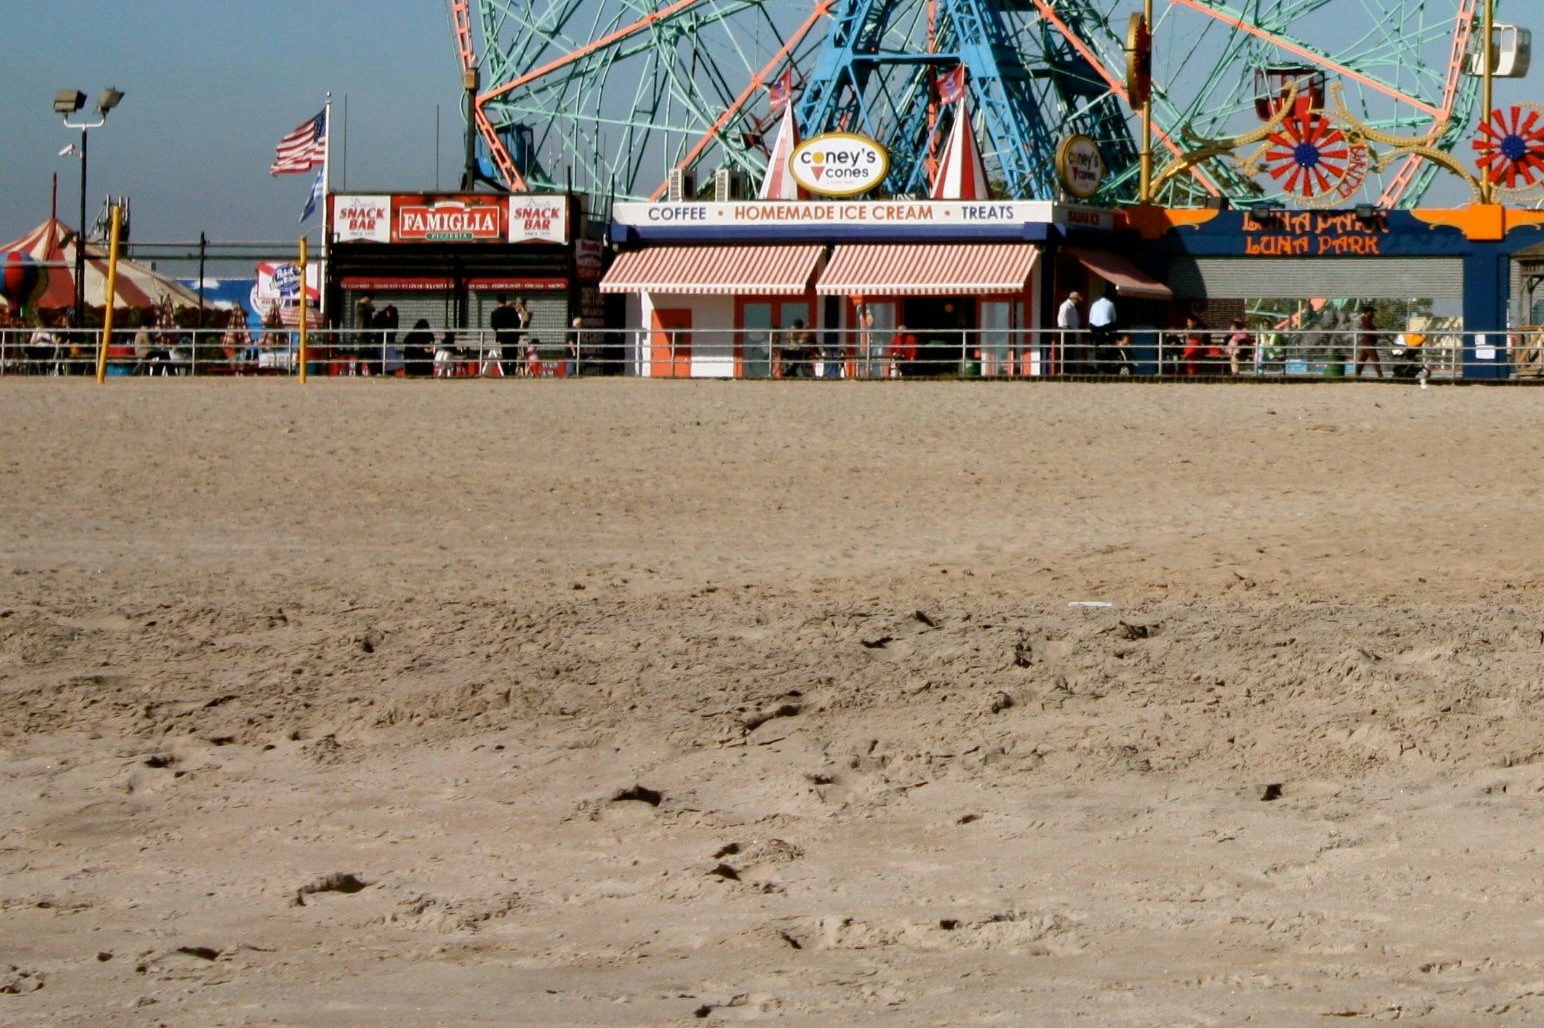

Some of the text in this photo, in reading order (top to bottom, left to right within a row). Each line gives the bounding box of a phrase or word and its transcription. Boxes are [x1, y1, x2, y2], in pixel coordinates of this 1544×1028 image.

[801, 148, 876, 167] coney's
[826, 168, 868, 178] cones
[1337, 143, 1368, 199] LUNA
[340, 208, 384, 219] SNACK
[515, 208, 559, 219] SNACK
[648, 207, 706, 220] COFFEE
[735, 206, 933, 220] HOMEMADE ICE CREAM
[962, 206, 1014, 219] TREATS
[349, 220, 376, 230] BAR
[403, 213, 494, 230] FAMIGLIA
[524, 220, 550, 230] BAR
[1245, 236, 1380, 254] LUNA PARK
